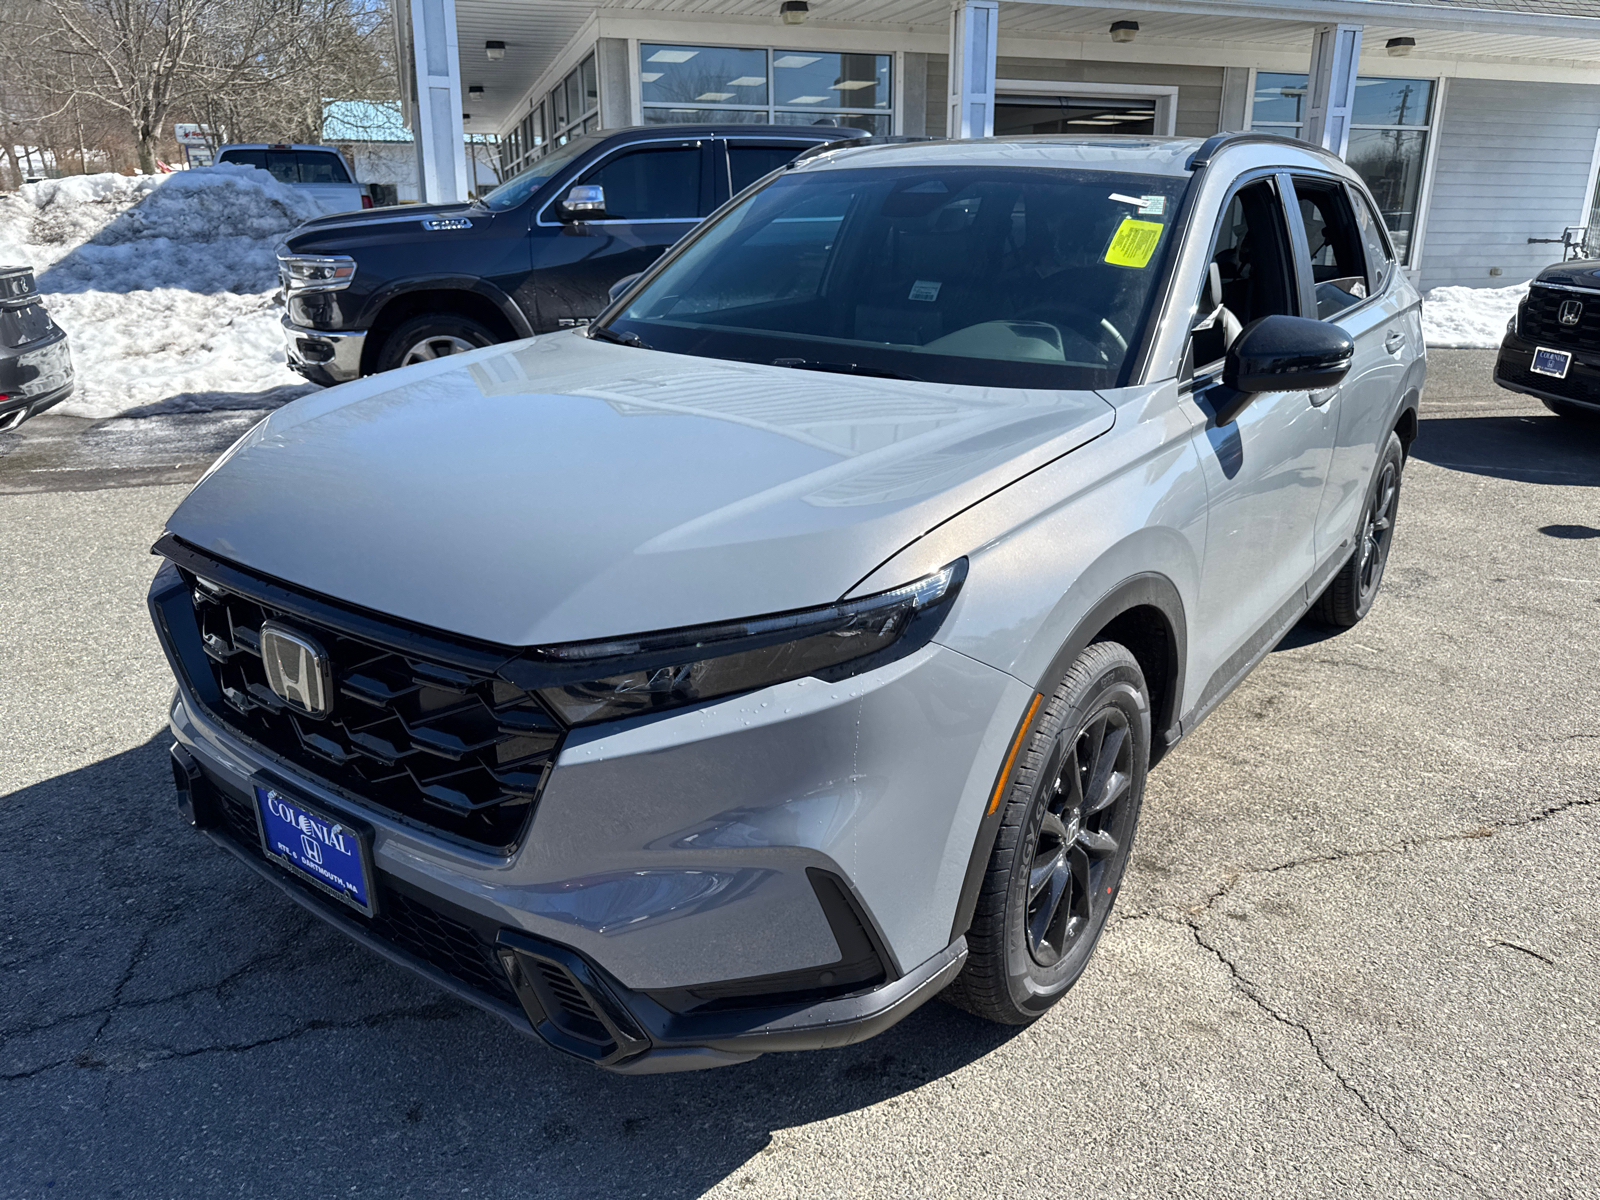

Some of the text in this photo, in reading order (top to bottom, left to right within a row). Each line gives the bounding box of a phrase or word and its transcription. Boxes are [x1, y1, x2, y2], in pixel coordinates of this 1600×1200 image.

[268, 797, 351, 856] COLONIAL
[1035, 784, 1048, 822] GT
[277, 842, 292, 856] RTE.
[301, 856, 346, 889] DARTMOUTH,
[346, 881, 358, 893] MA
